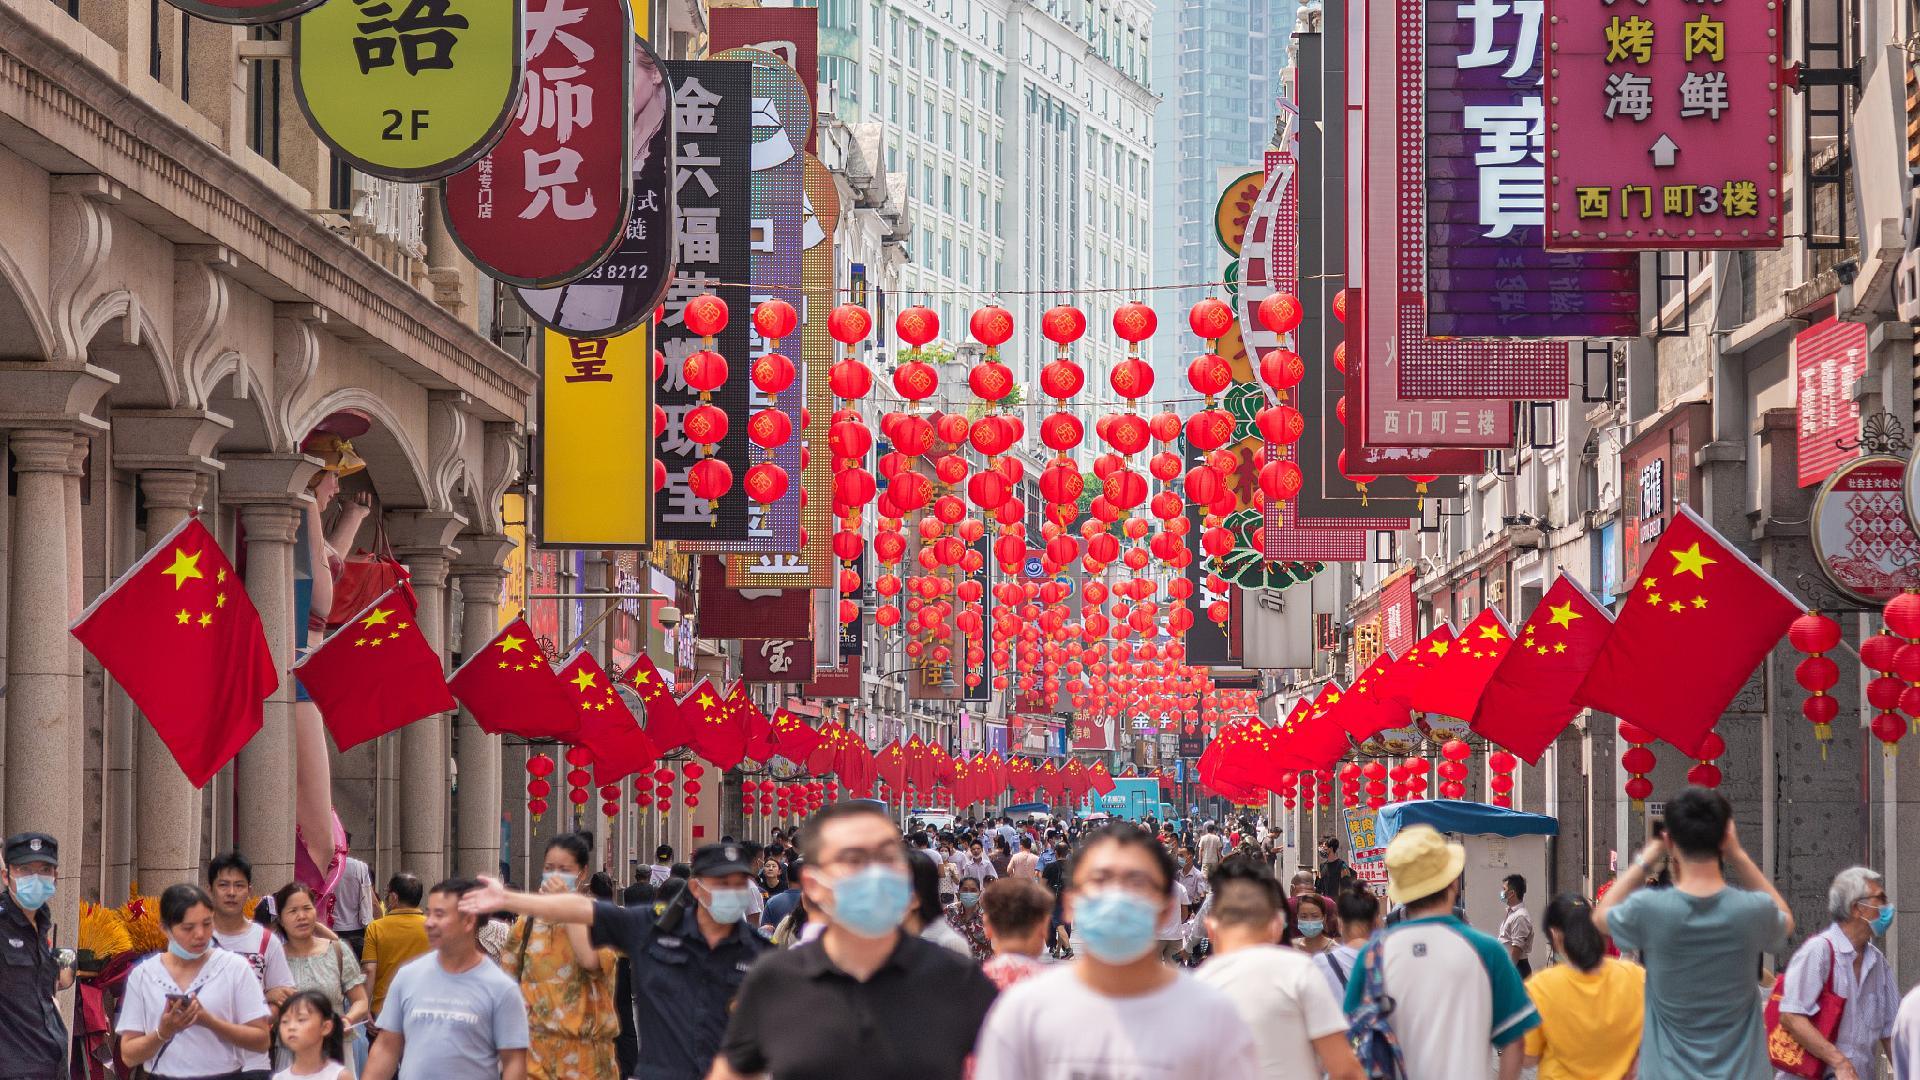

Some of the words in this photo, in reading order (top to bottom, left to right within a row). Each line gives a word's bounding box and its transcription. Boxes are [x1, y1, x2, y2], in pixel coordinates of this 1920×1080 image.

[1605, 14, 1726, 64] 烤肉
[1604, 72, 1729, 121] 海鲜
[381, 109, 430, 142] 2F
[1576, 180, 1759, 219] 西门町3楼
[607, 265, 649, 279] 8212
[1384, 409, 1495, 435] 西门町三楼
